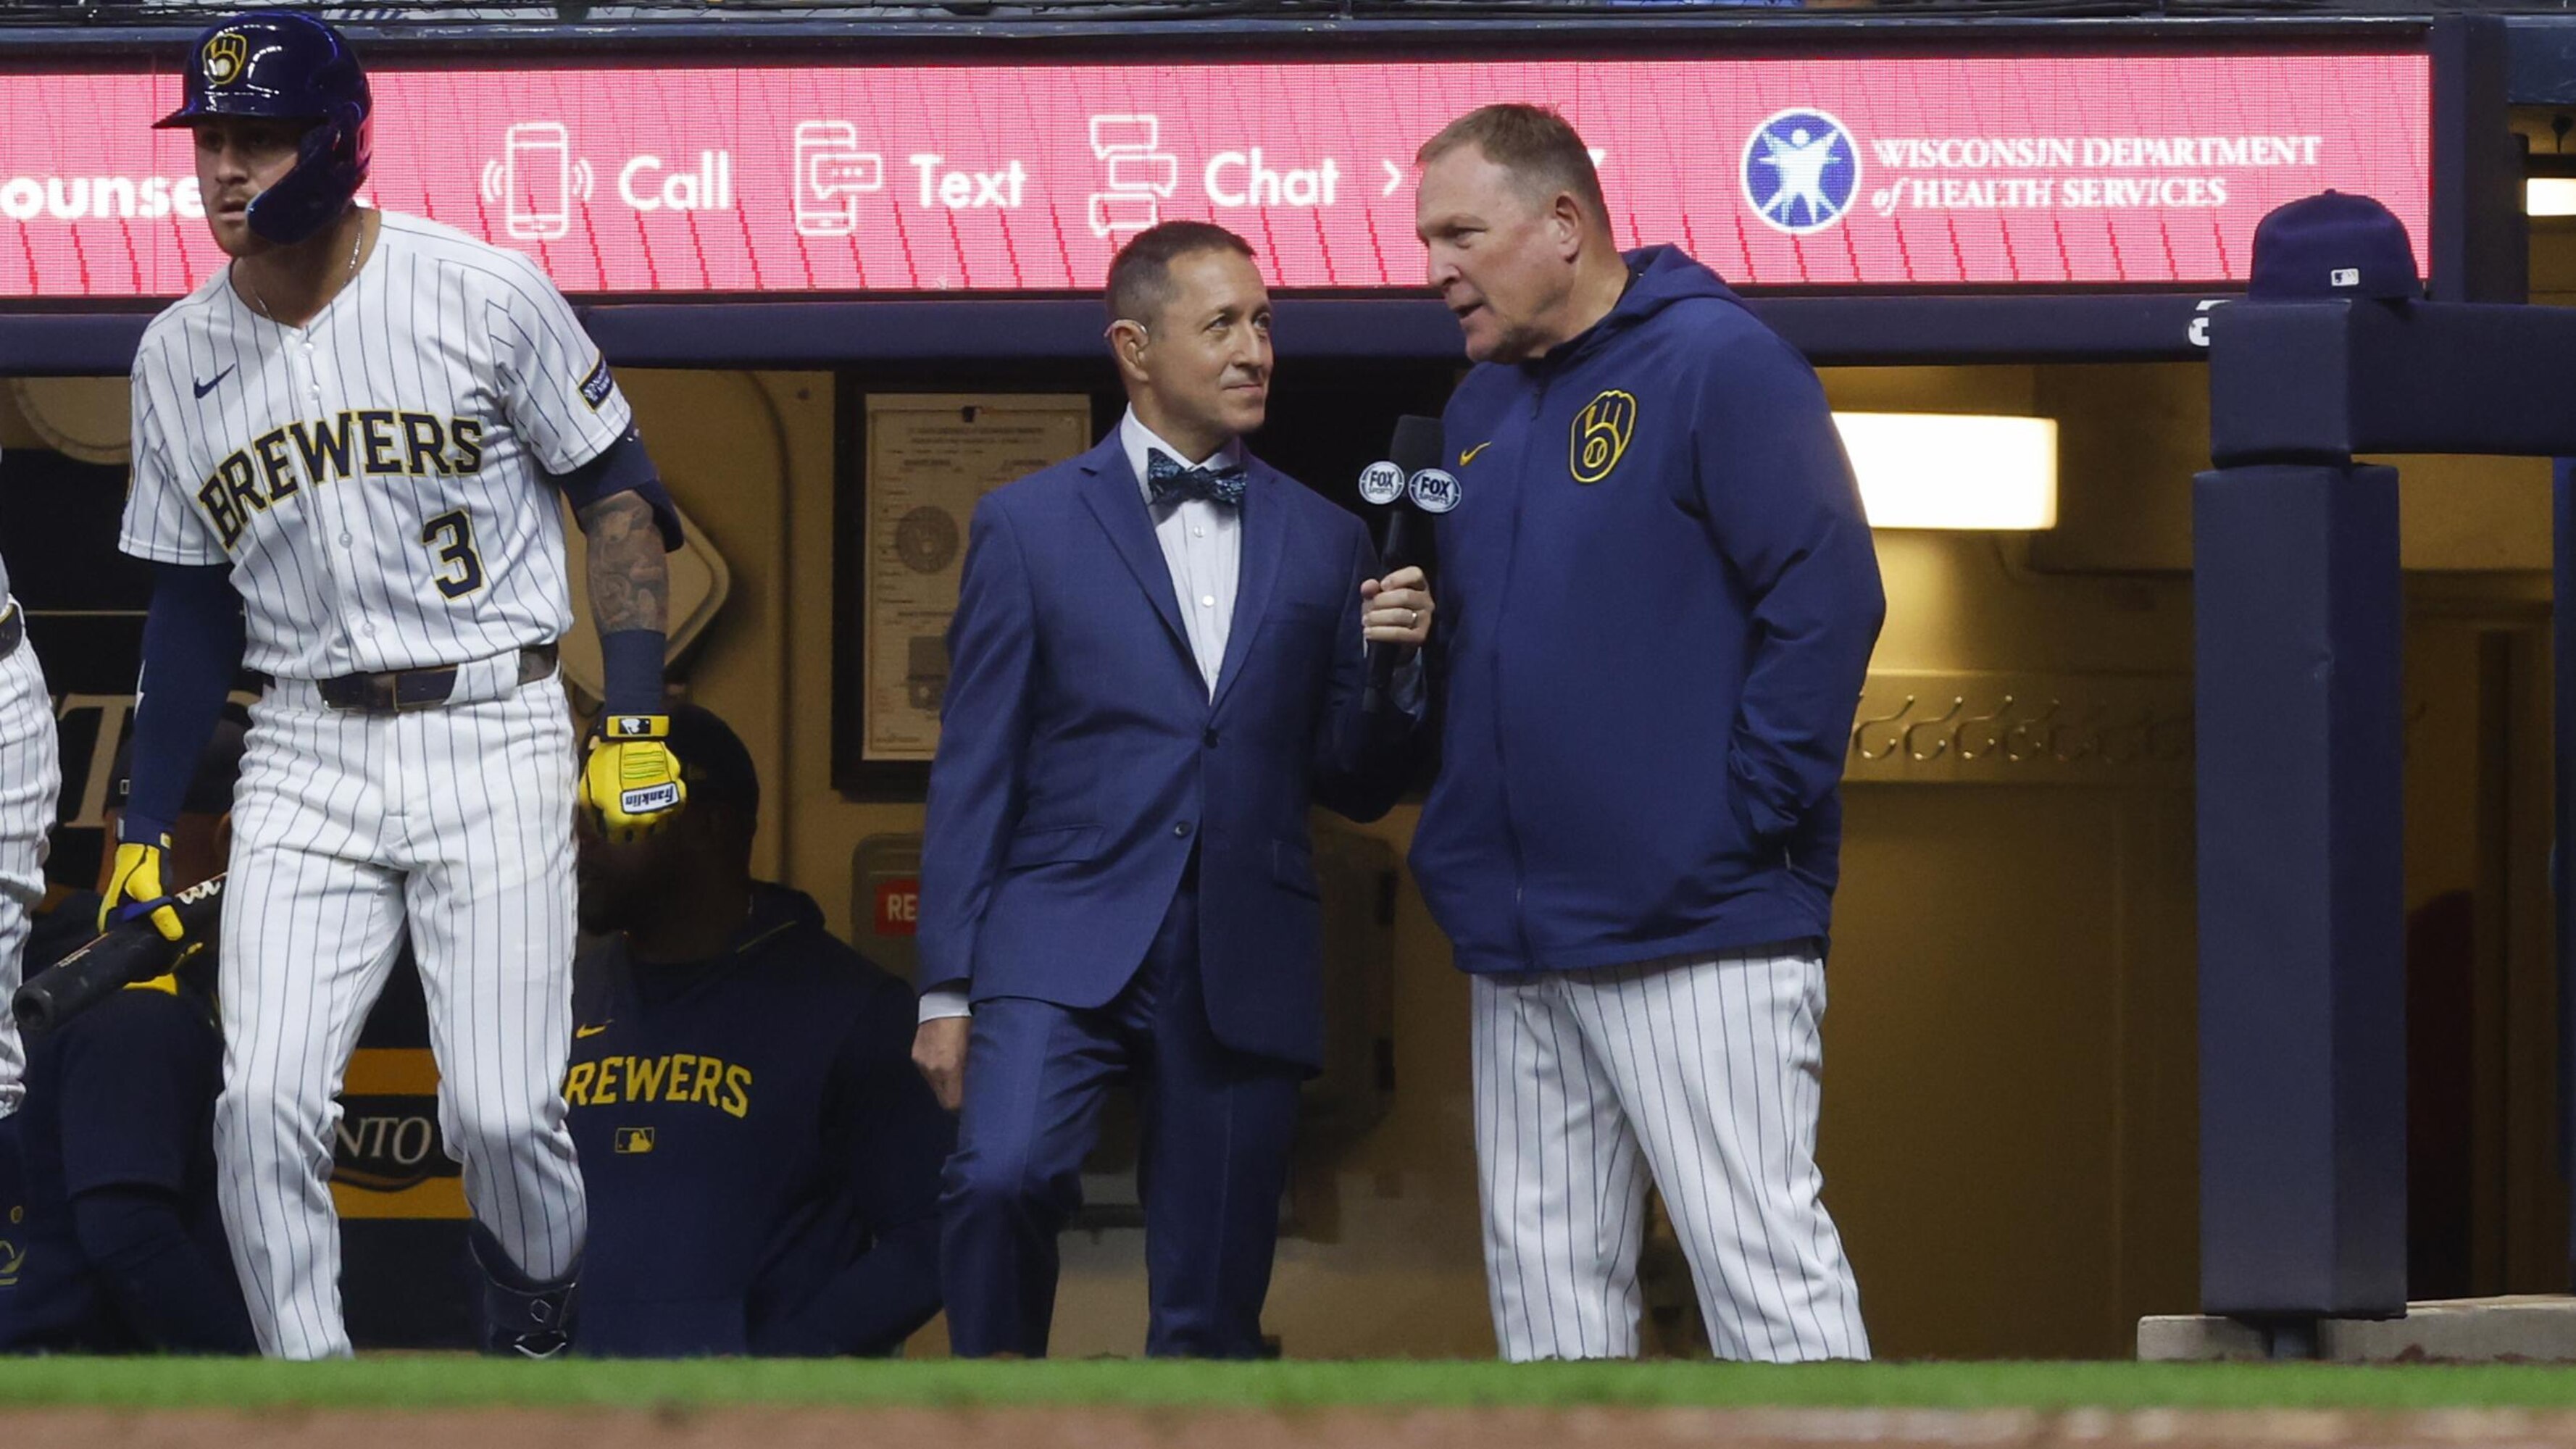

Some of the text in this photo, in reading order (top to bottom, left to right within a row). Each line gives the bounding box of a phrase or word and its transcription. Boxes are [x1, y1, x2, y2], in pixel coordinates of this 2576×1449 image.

[1871, 135, 2321, 168] WISCONSIN DEPARTMENT
[618, 150, 730, 211] Call
[909, 154, 1026, 209] Text
[1204, 147, 1340, 206] Chat
[1871, 177, 2227, 217] of HEALTH SERVICES
[197, 409, 483, 553] BREWERS
[1370, 471, 1396, 488] FOX
[1421, 476, 1451, 498] FOX
[422, 509, 483, 601] 3
[888, 893, 917, 921] RE
